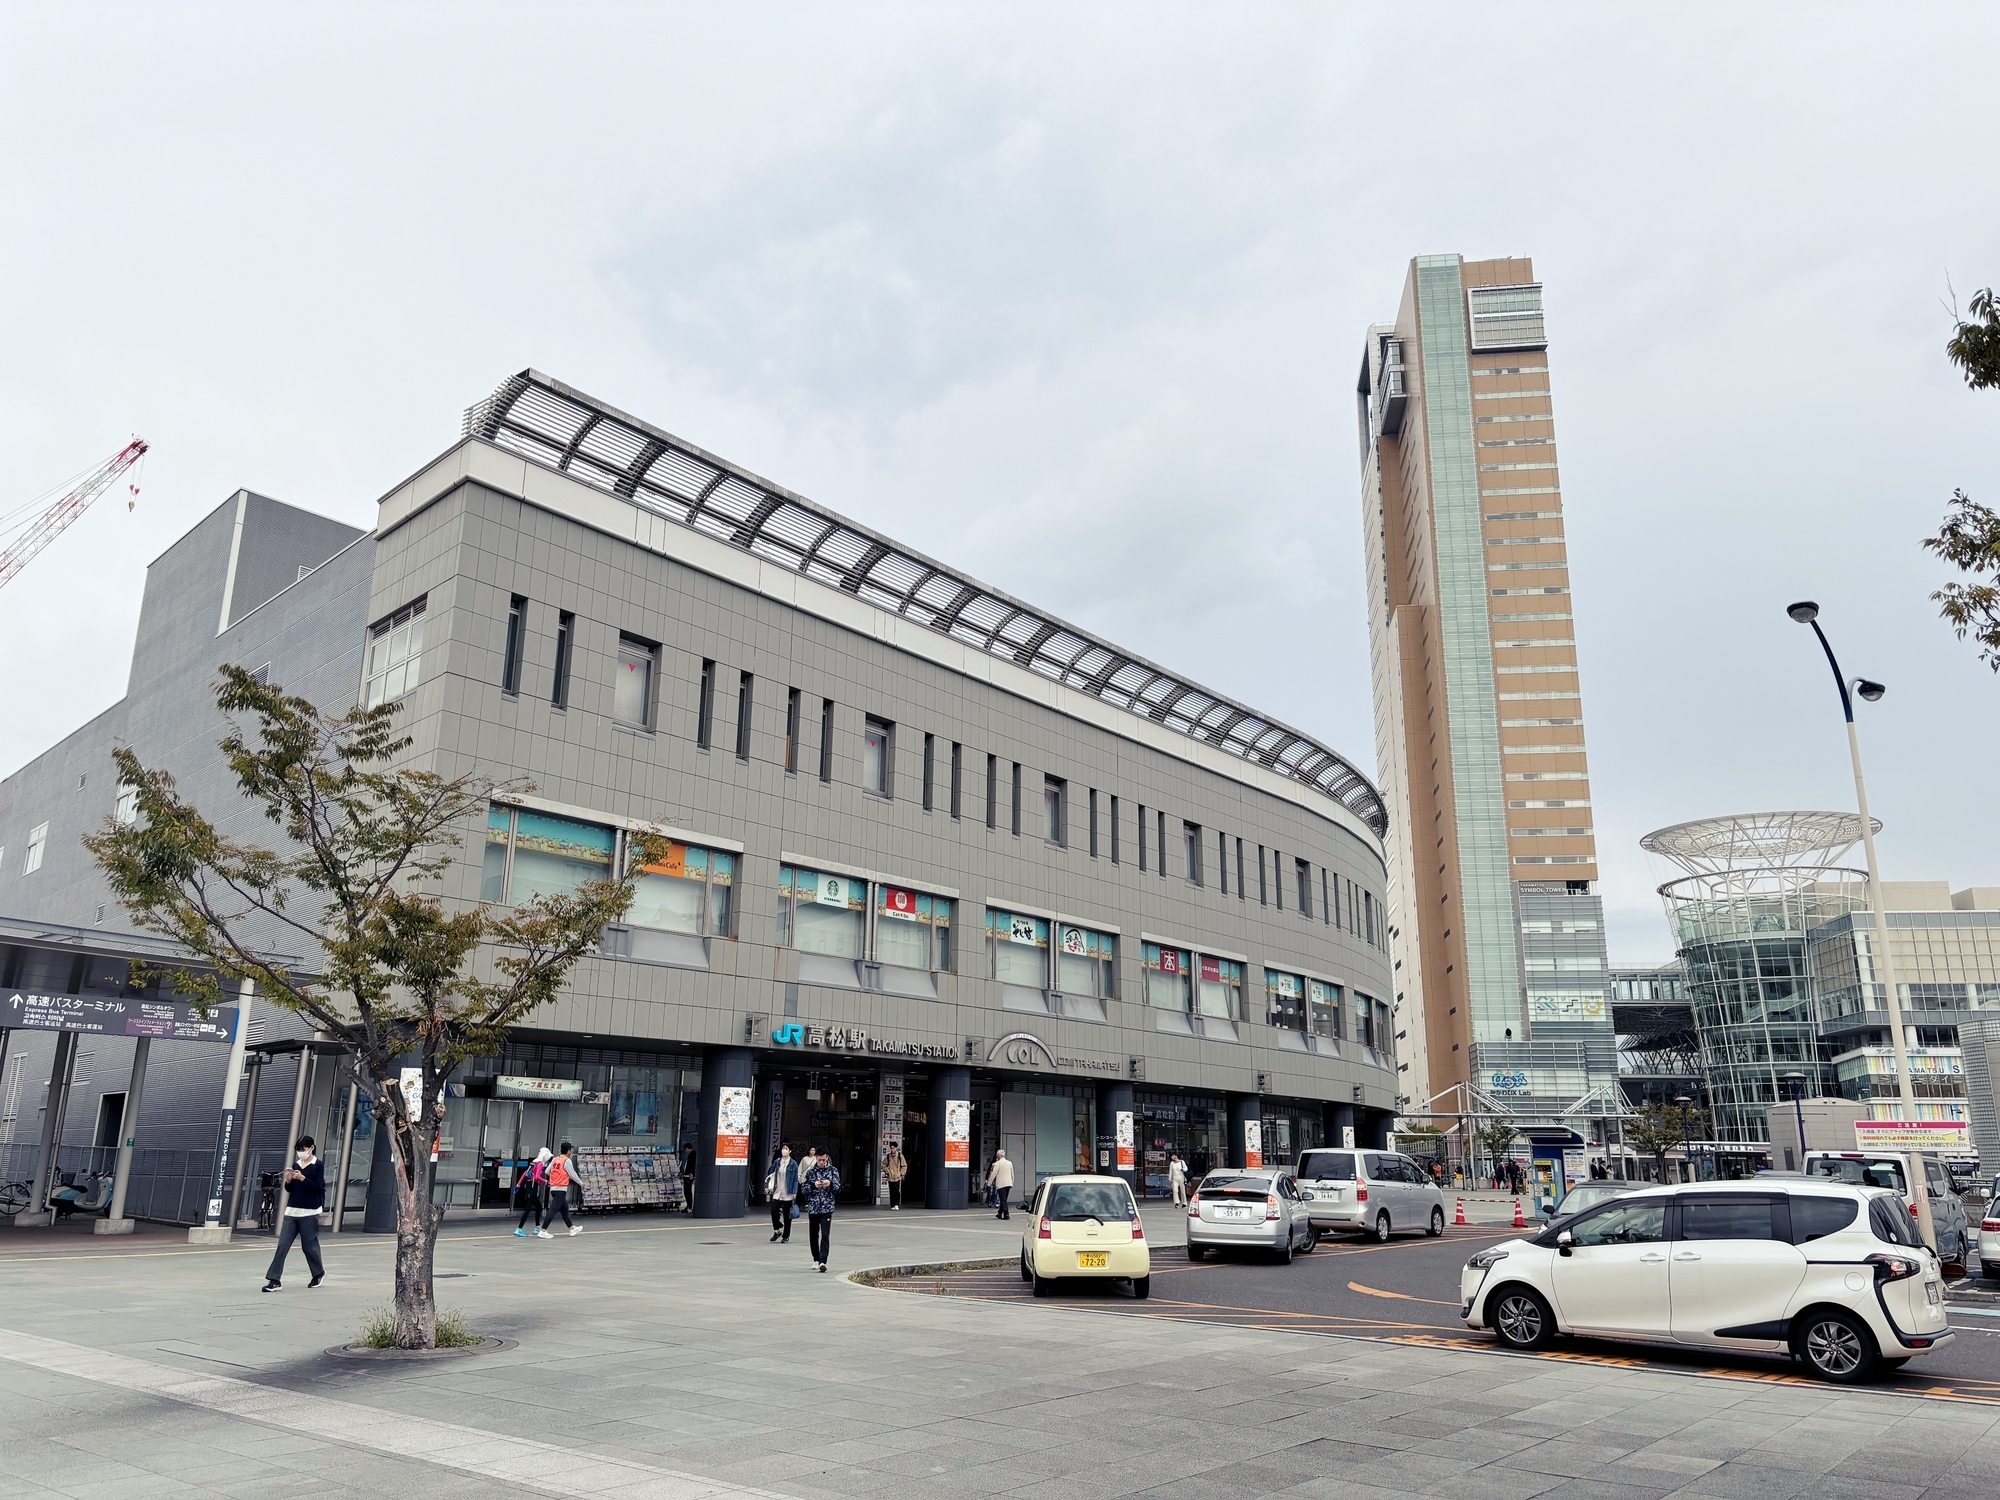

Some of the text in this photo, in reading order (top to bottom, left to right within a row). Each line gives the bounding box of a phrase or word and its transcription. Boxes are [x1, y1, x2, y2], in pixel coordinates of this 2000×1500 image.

[24, 1006, 47, 1014] Express
[48, 1007, 60, 1015] Bus
[26, 994, 126, 1013] 高速バスターミナル
[773, 1024, 961, 1058] JR 高松駅 TAKAMATSU STATION
[772, 1103, 781, 1153] クリーニング
[1085, 1258, 1106, 1266] 72-20
